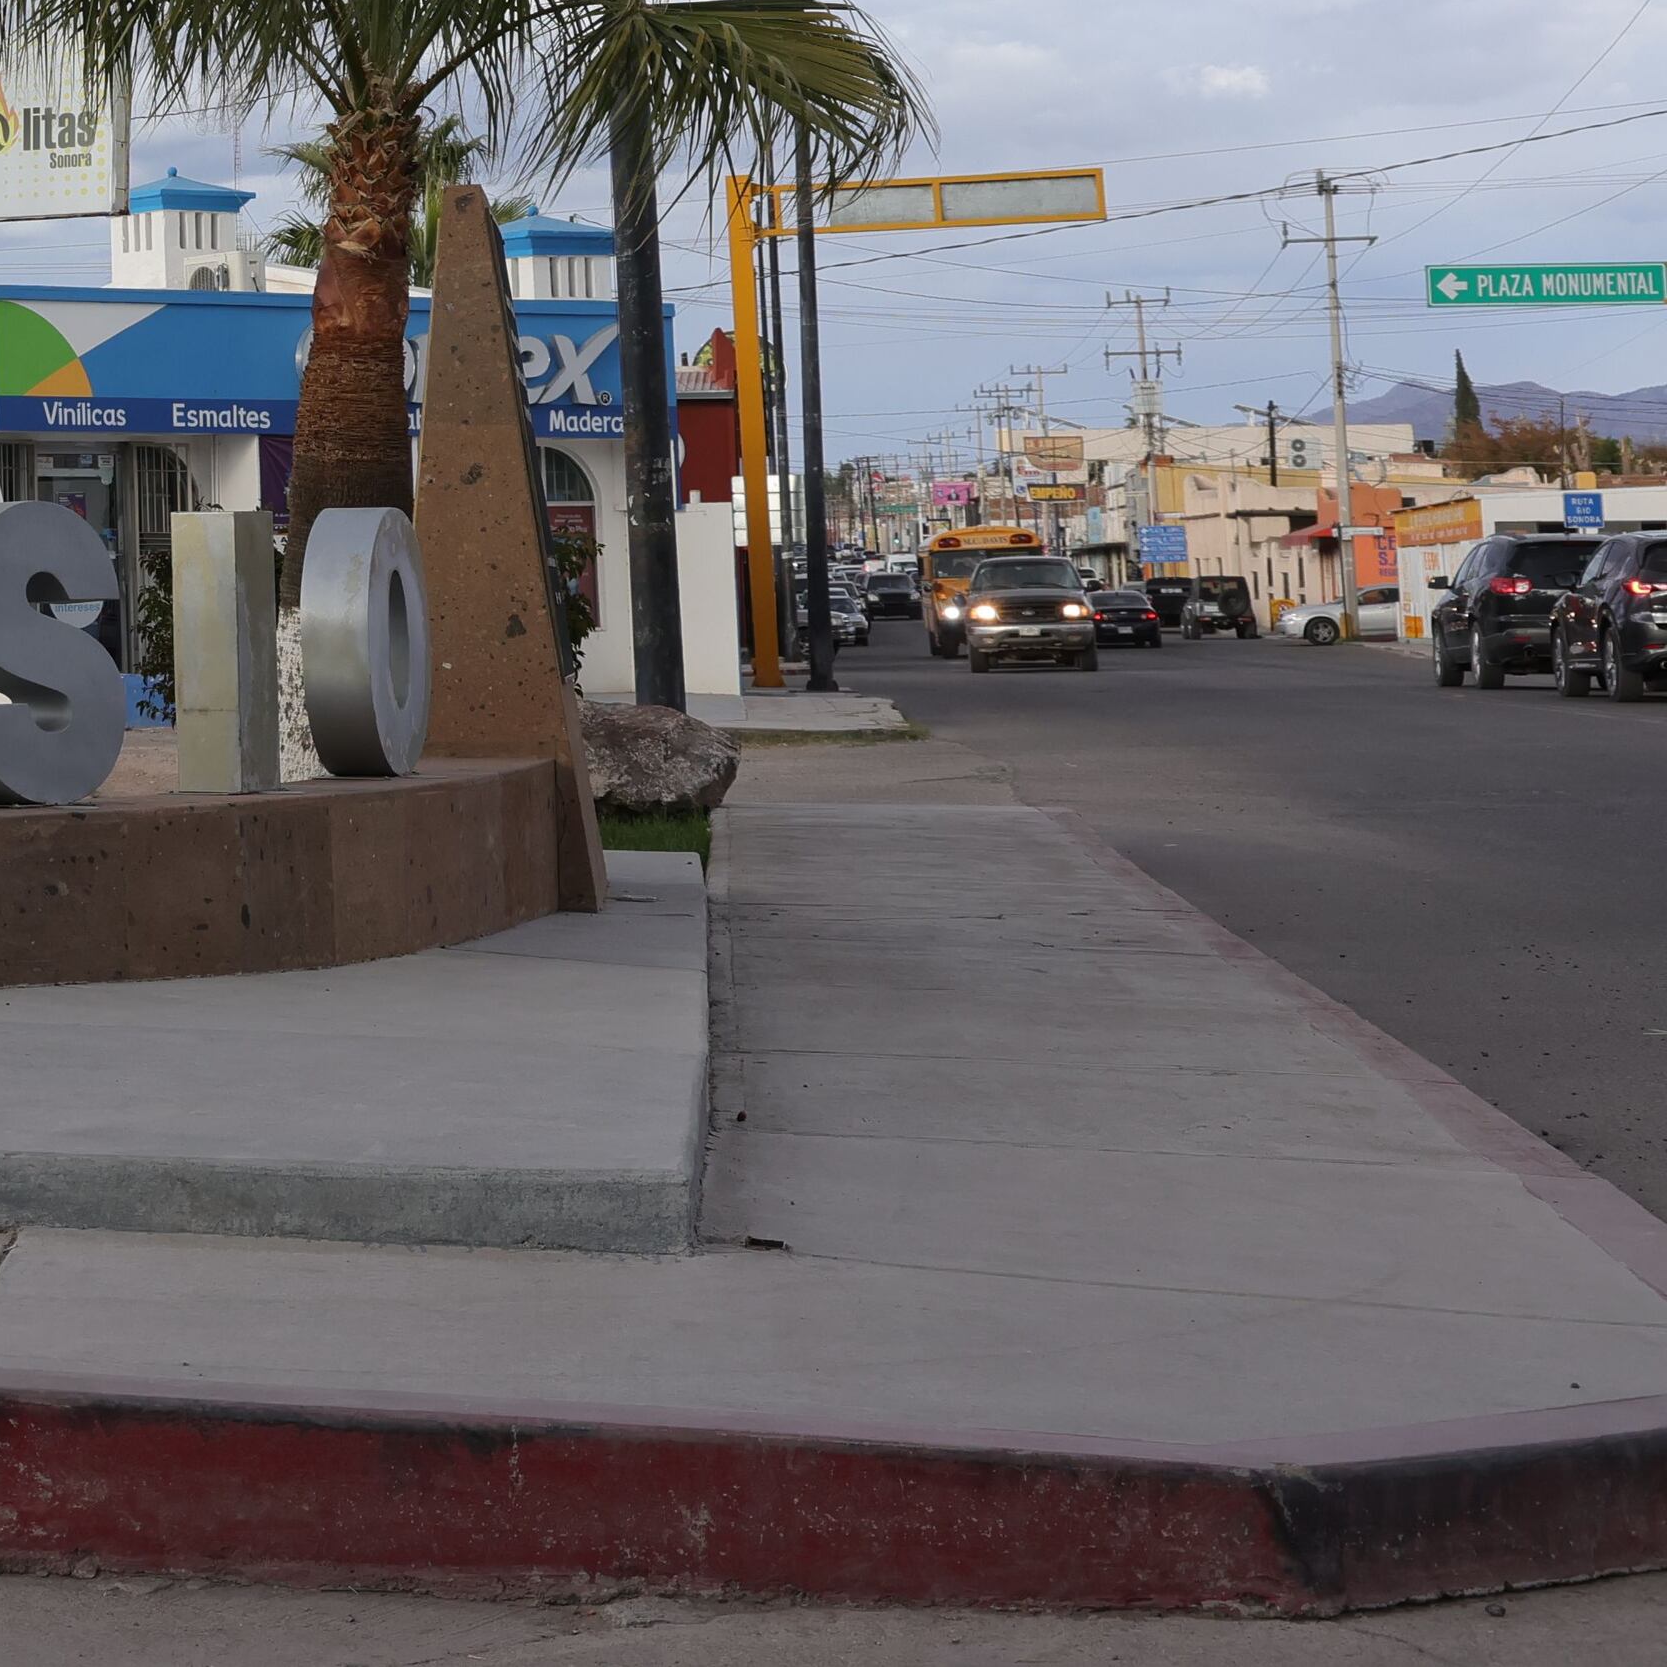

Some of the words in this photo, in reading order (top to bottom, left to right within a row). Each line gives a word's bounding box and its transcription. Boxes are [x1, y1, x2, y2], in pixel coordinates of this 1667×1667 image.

[49, 152, 92, 169] Sonora
[1476, 273, 1535, 298] PLAZA
[1541, 271, 1660, 297] MONUMENTAL
[42, 401, 127, 427] Vinílicas
[172, 403, 271, 429] Esmaltes
[1571, 497, 1594, 506] RUTA
[1567, 515, 1602, 524] SONORA
[54, 603, 102, 613] intereses
